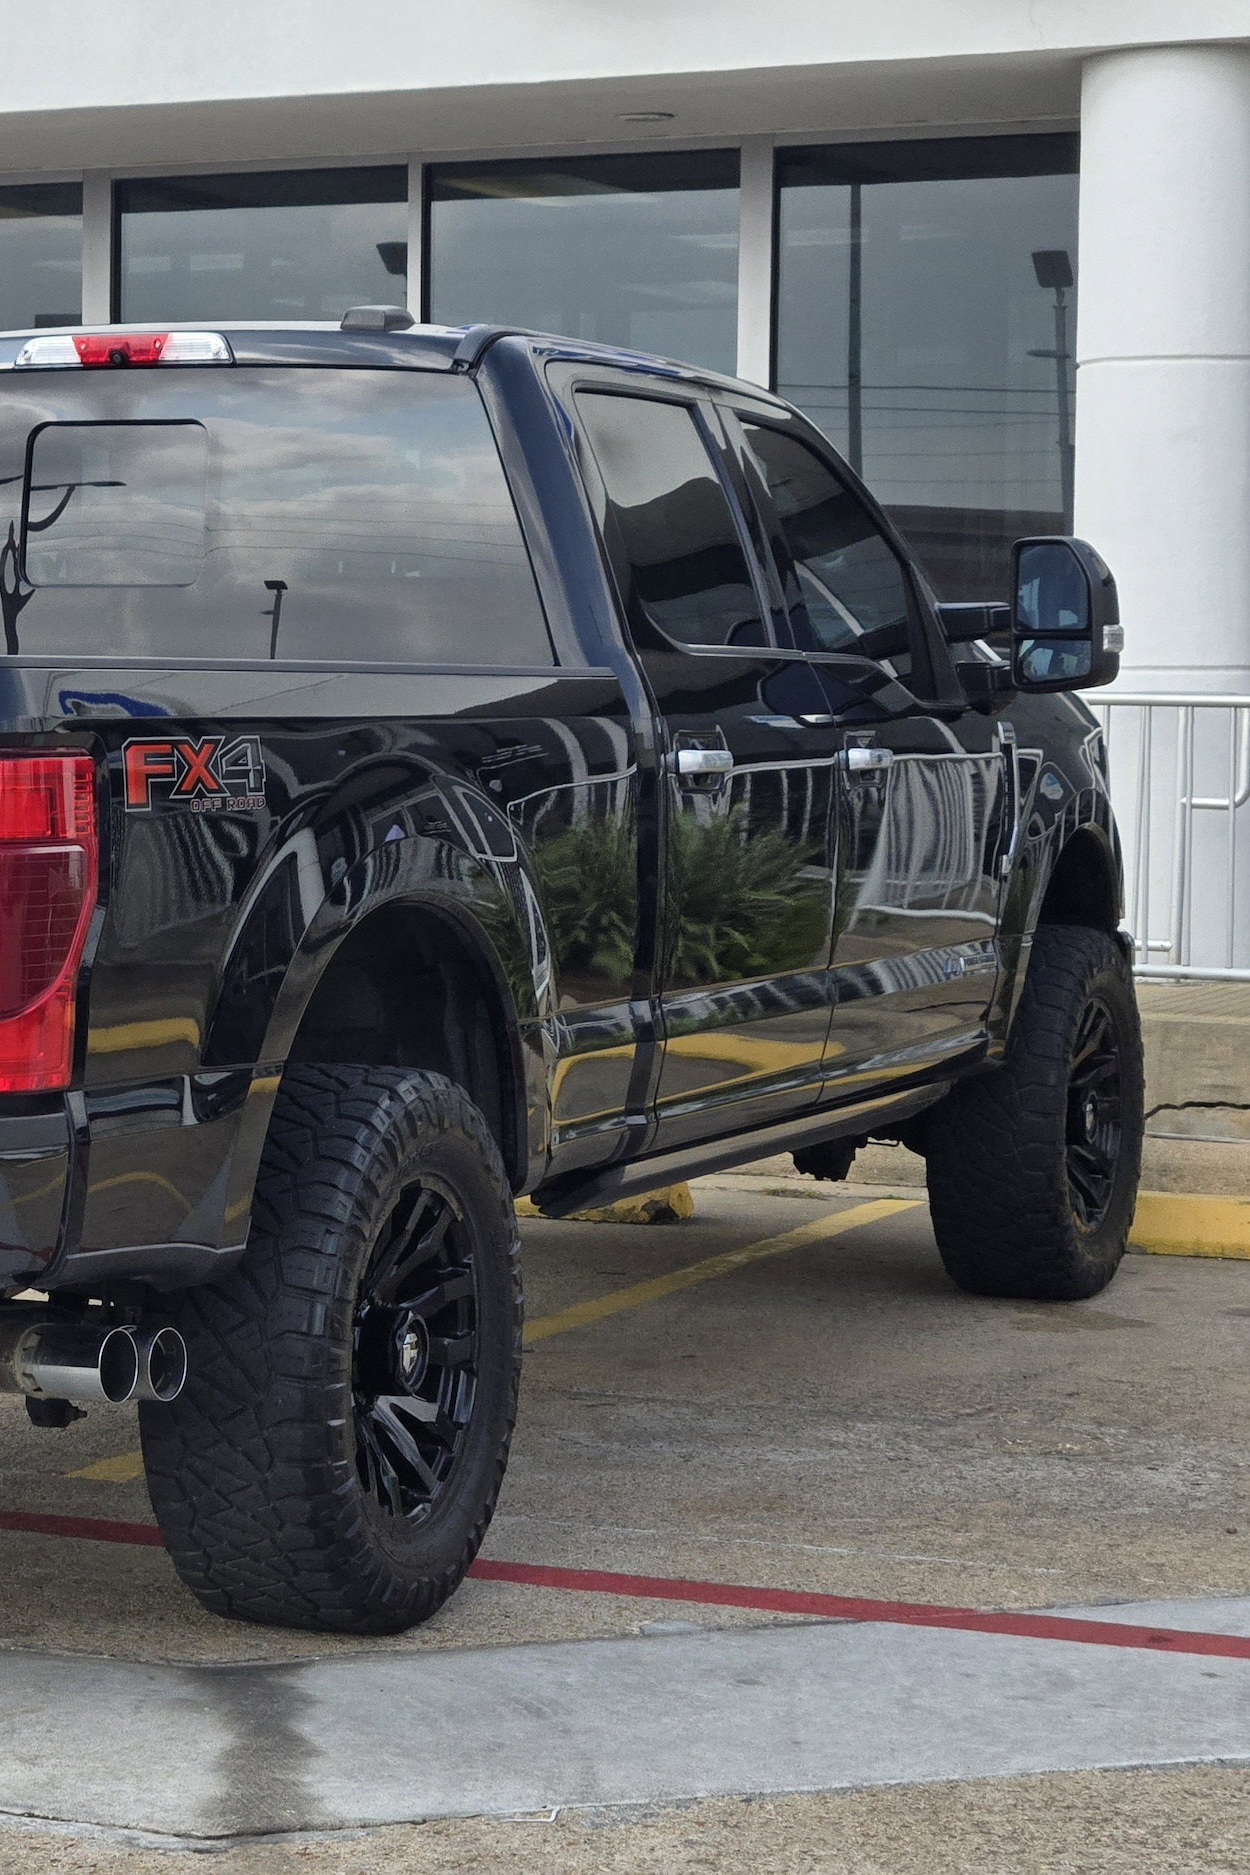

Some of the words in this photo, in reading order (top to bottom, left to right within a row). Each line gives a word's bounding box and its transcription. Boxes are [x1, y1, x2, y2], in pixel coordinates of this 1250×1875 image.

[121, 735, 267, 813] FX4
[190, 799, 223, 813] OFF
[226, 796, 267, 812] ROAD
